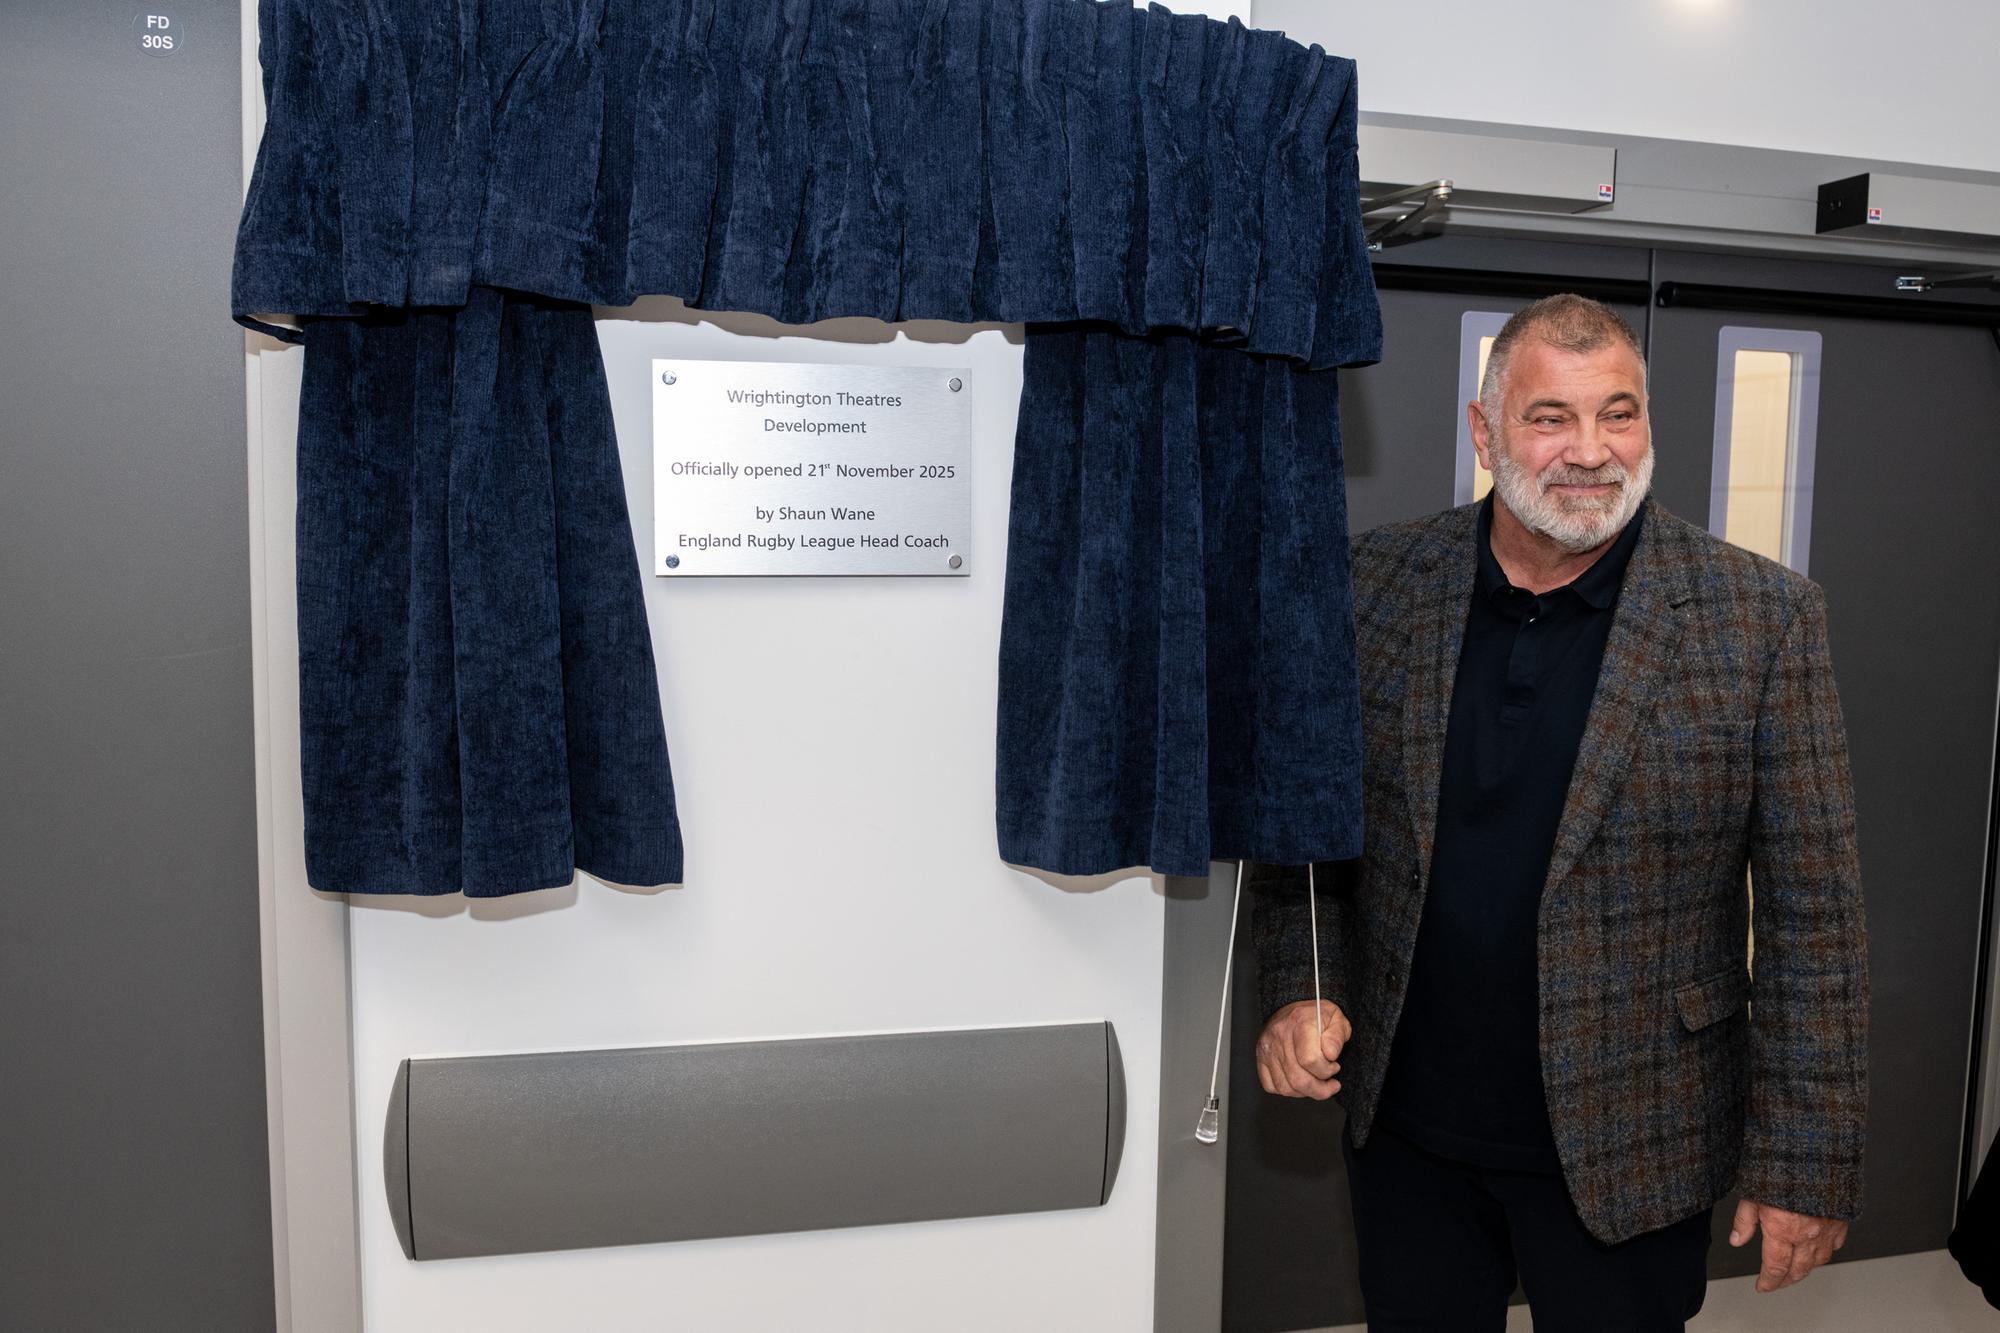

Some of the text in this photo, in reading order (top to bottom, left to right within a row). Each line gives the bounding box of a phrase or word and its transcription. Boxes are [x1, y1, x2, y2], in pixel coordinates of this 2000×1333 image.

[147, 15, 170, 29] FD
[142, 35, 173, 49] 30S
[727, 390, 902, 408] Wrightington Theatres
[764, 419, 867, 436] Development
[671, 462, 956, 479] Officially opened 21st November 2025
[756, 506, 876, 524] by Shaun Wane
[679, 533, 949, 551] England Rugby League Head Coach
